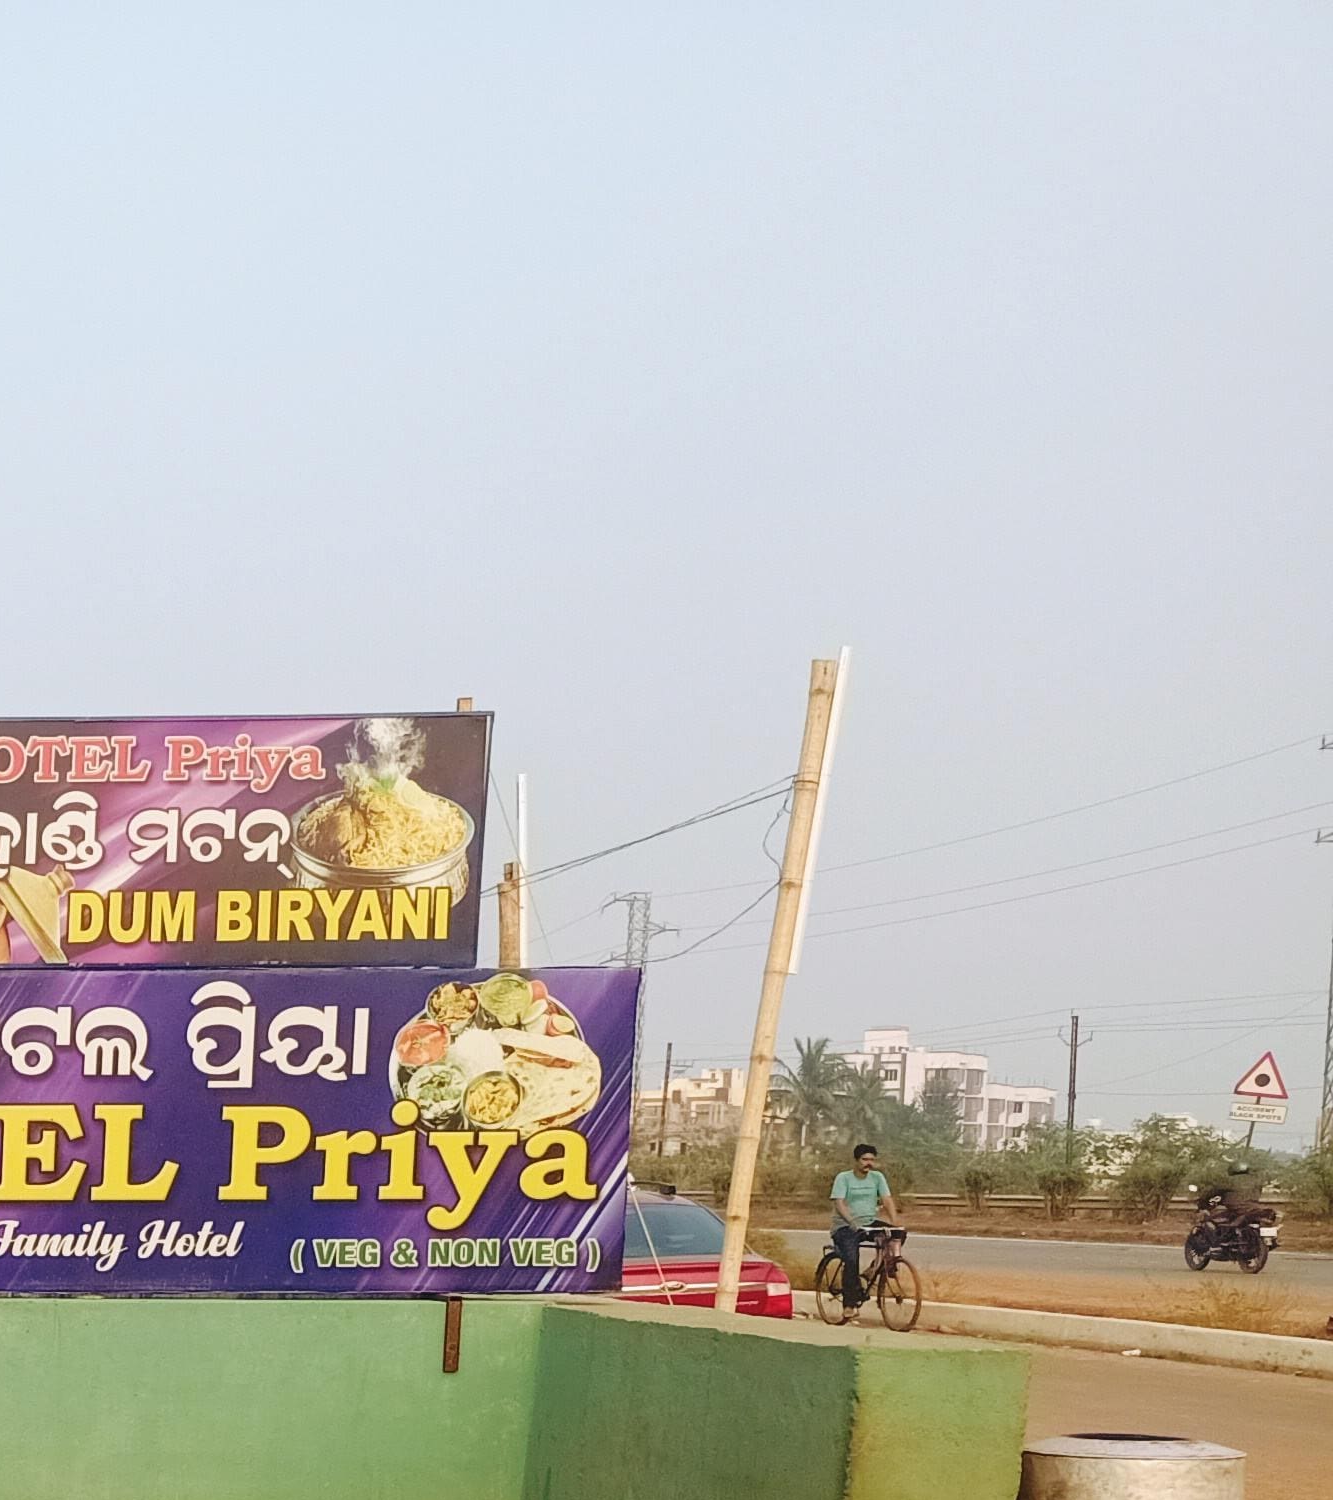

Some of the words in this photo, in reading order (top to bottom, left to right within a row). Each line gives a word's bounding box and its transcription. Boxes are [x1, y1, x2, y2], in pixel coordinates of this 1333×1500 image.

[164, 734, 326, 793] Priya
[67, 891, 198, 945] DUM
[216, 887, 451, 942] BIRYANI
[217, 1100, 598, 1230] Priya
[136, 1219, 246, 1258] Hotel
[390, 1238, 418, 1268] &
[427, 1238, 500, 1267] NON
